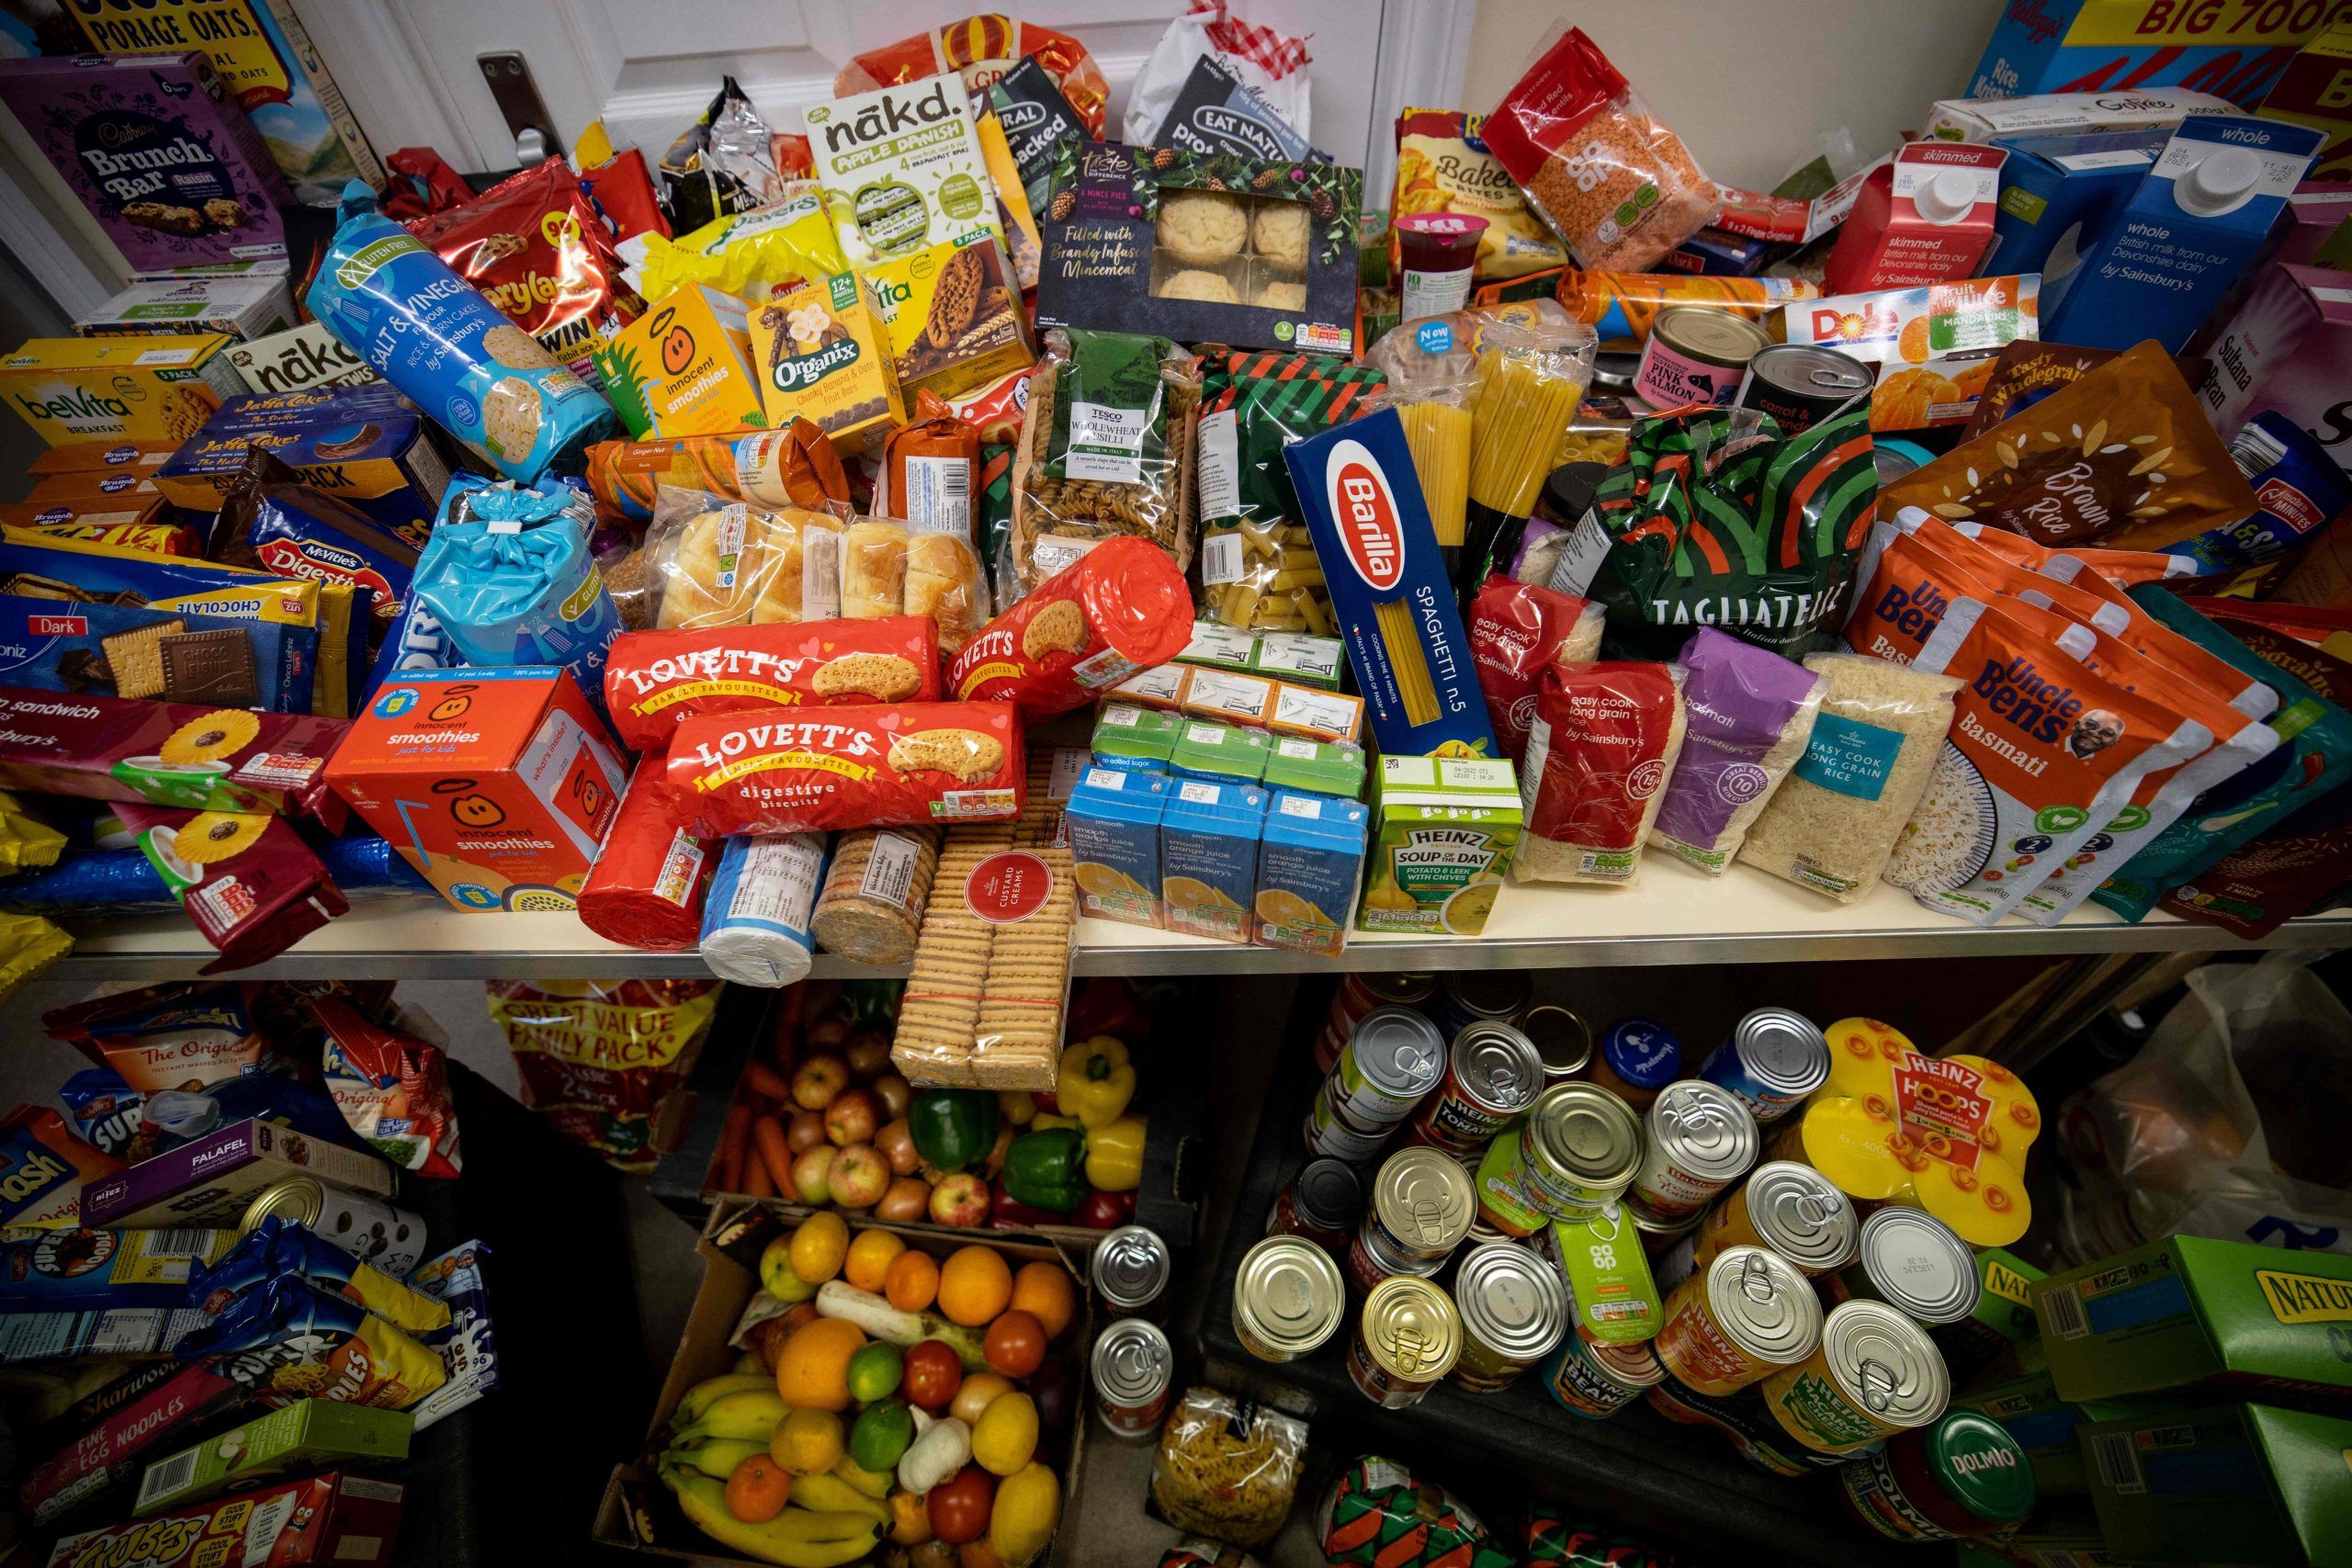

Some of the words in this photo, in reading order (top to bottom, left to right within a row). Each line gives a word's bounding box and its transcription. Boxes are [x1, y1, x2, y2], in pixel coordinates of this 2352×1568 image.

[88, 15, 187, 51] PORAGE
[192, 8, 253, 40] OATS
[2136, 2, 2223, 35] BIG
[1992, 58, 2020, 89] Rice
[1546, 84, 1565, 106] Red
[97, 121, 157, 148] Cadbury
[837, 145, 892, 170] APPLE
[897, 121, 959, 151] DANISH
[1205, 111, 1237, 131] EAT
[1239, 122, 1283, 161] NATU
[2222, 128, 2271, 144] whole
[82, 138, 214, 176] Brunch
[912, 152, 950, 167] BREAKFAST
[953, 147, 968, 157] BARS
[1922, 150, 1982, 164] skimmed
[105, 172, 164, 201] Bar
[1088, 190, 1108, 198] MINCE
[1111, 191, 1126, 199] PIES
[1456, 186, 1505, 200] BITES
[957, 237, 963, 247] 5
[965, 228, 989, 244] PACK
[1066, 226, 1102, 243] Filled
[1104, 226, 1135, 241] with
[2127, 223, 2170, 240] whole
[359, 244, 391, 268] GLUTEN
[390, 241, 410, 253] FREE
[1049, 243, 1101, 263] Brandy
[2112, 247, 2174, 266] Devonshire
[2176, 261, 2207, 276] dairy
[2119, 236, 2150, 250] British
[2151, 243, 2175, 255] milk
[2177, 247, 2205, 260] from
[2206, 254, 2228, 265] our
[1062, 261, 1137, 278] Mincemeat
[2100, 262, 2120, 278] by
[2119, 266, 2194, 290] Sainsbury's
[831, 277, 851, 292] 12+
[834, 288, 854, 299] months
[413, 307, 447, 335] FLAVOUR
[537, 318, 593, 351] WIN
[1812, 303, 1899, 341] Dole
[370, 327, 397, 372] SALT
[389, 316, 410, 333] &
[425, 356, 441, 372] by
[435, 319, 485, 358] Sainsbury's
[160, 370, 167, 379] 5
[169, 368, 197, 379] PACK
[666, 356, 715, 395] innocent
[775, 343, 856, 387] Organix
[1650, 364, 1685, 388] PINK
[2219, 334, 2252, 391] Sultana
[667, 367, 729, 413] smoothies
[797, 389, 823, 406] Chunky
[823, 373, 850, 391] Banana
[852, 367, 857, 378] &
[859, 361, 875, 375] Date
[824, 393, 841, 406] Fruit
[842, 384, 858, 397] Bars
[1645, 372, 1696, 402] SALMON
[2205, 365, 2225, 412] Bran
[16, 384, 132, 420] belVita
[1092, 409, 1123, 420] TESCO
[66, 423, 127, 434] BREAKFAST
[1071, 421, 1142, 436] WHOLEWHEAT
[2046, 461, 2109, 529] Brown
[1343, 478, 1394, 578] Barilla
[2022, 496, 2072, 534] Rice
[2276, 499, 2312, 530] MINUTES
[306, 545, 357, 568] McVitie's
[177, 601, 261, 613] CHOCOLATE
[40, 619, 74, 636] Dark
[944, 628, 1017, 694] LOVETT'S
[1415, 584, 1457, 681] SPAGHETTI
[1447, 688, 1466, 712] n.5
[628, 646, 799, 695] LOVETT'S
[1371, 634, 1383, 661] COOKING
[1379, 661, 1388, 674] TIME
[1385, 680, 1397, 704] MINUTES
[2007, 655, 2083, 717] Uncle
[9, 701, 100, 720] sandwich
[1569, 705, 1596, 719] long
[1599, 707, 1631, 719] grain
[1571, 695, 1596, 708] easy
[1600, 698, 1633, 709] cook
[1683, 694, 1737, 728] basmati
[1973, 660, 2070, 744] Ben's
[387, 730, 481, 745] smoothies
[695, 723, 875, 770] LOVETT'S
[1566, 729, 1579, 741] by
[1581, 732, 1645, 749] Sainsbury's
[1958, 712, 2049, 777] Basmati
[769, 755, 852, 773] FAVOURITES
[1806, 751, 1837, 767] LONG
[1841, 762, 1882, 778] GRAIN
[1812, 742, 1841, 756] EASY
[1845, 751, 1882, 767] COOK
[1825, 768, 1851, 782] RICE
[740, 784, 836, 801] digestive
[760, 796, 820, 808] biscuits
[457, 840, 555, 850] smoothies
[1416, 831, 1484, 846] HEINZ
[1170, 863, 1182, 871] by
[1182, 863, 1232, 877] Sainsbury's
[1398, 852, 1441, 863] SOUP
[1457, 853, 1489, 864] DAY
[999, 865, 1015, 908] CUSTARD
[1009, 867, 1025, 904] CREAMS
[594, 1004, 674, 1037] VALUE
[141, 1048, 175, 1066] The
[592, 1035, 667, 1063] PACK
[152, 1063, 183, 1074] INSTANT
[186, 1059, 214, 1069] MASHED
[217, 1056, 247, 1066] POTATO
[1912, 1057, 1978, 1089] HEINZ
[1904, 1077, 1980, 1120] HOOPS
[192, 1136, 247, 1168] FALAFEL
[1682, 1311, 1733, 1374] HOOPS
[1696, 1309, 1747, 1369] HEINZ
[471, 1356, 487, 1367] 96
[1579, 1359, 1628, 1398] HEINZ
[117, 1395, 184, 1447] NOODLES
[1818, 1380, 1874, 1434] HEINZ
[77, 1443, 110, 1472] EGG
[1951, 1449, 2017, 1474] DOLMIO
